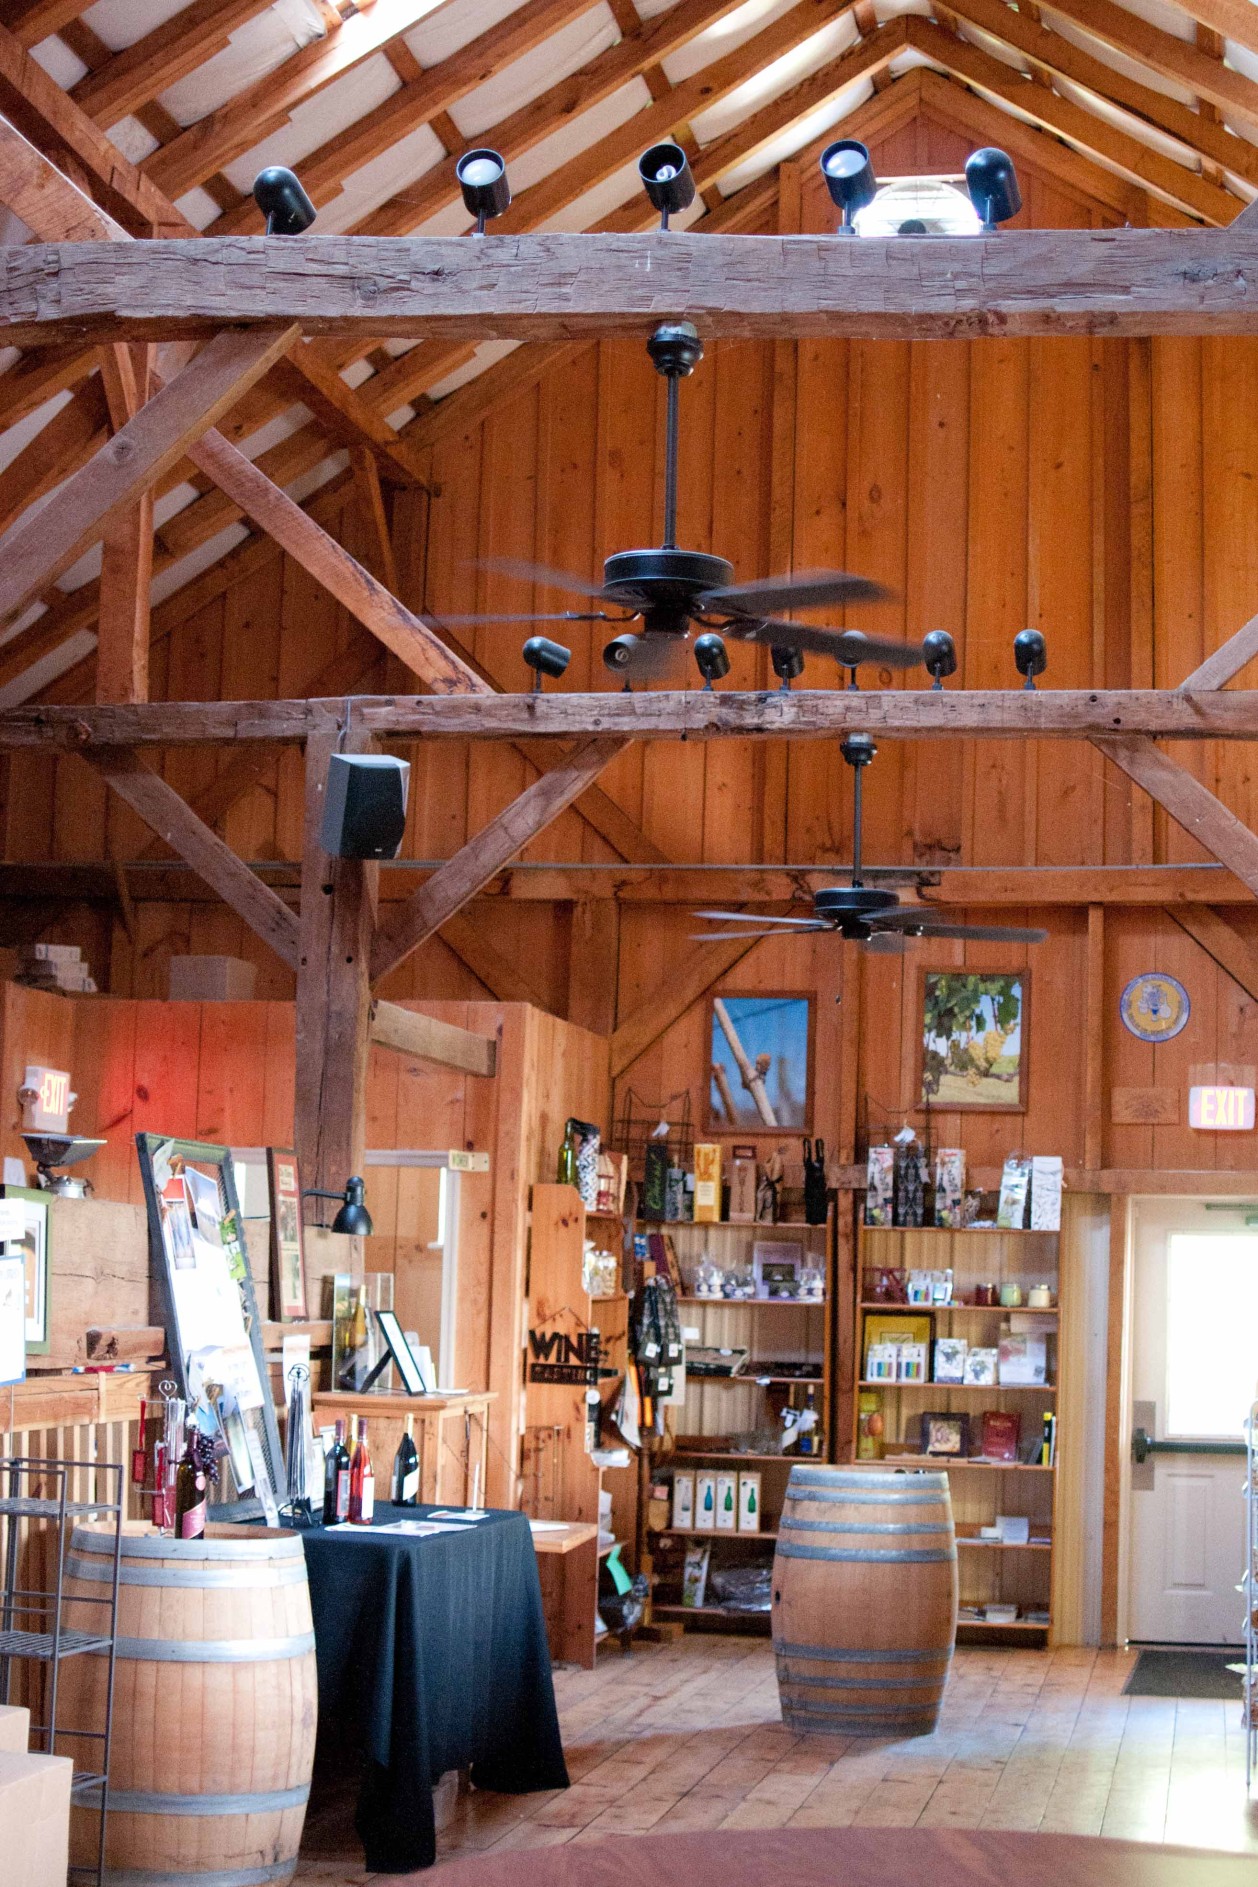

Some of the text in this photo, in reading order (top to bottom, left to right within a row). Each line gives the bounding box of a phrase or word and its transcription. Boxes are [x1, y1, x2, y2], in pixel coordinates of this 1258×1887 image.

[43, 1073, 66, 1115] EXIT
[1200, 1089, 1248, 1126] EXIT
[529, 1329, 600, 1363] WINE
